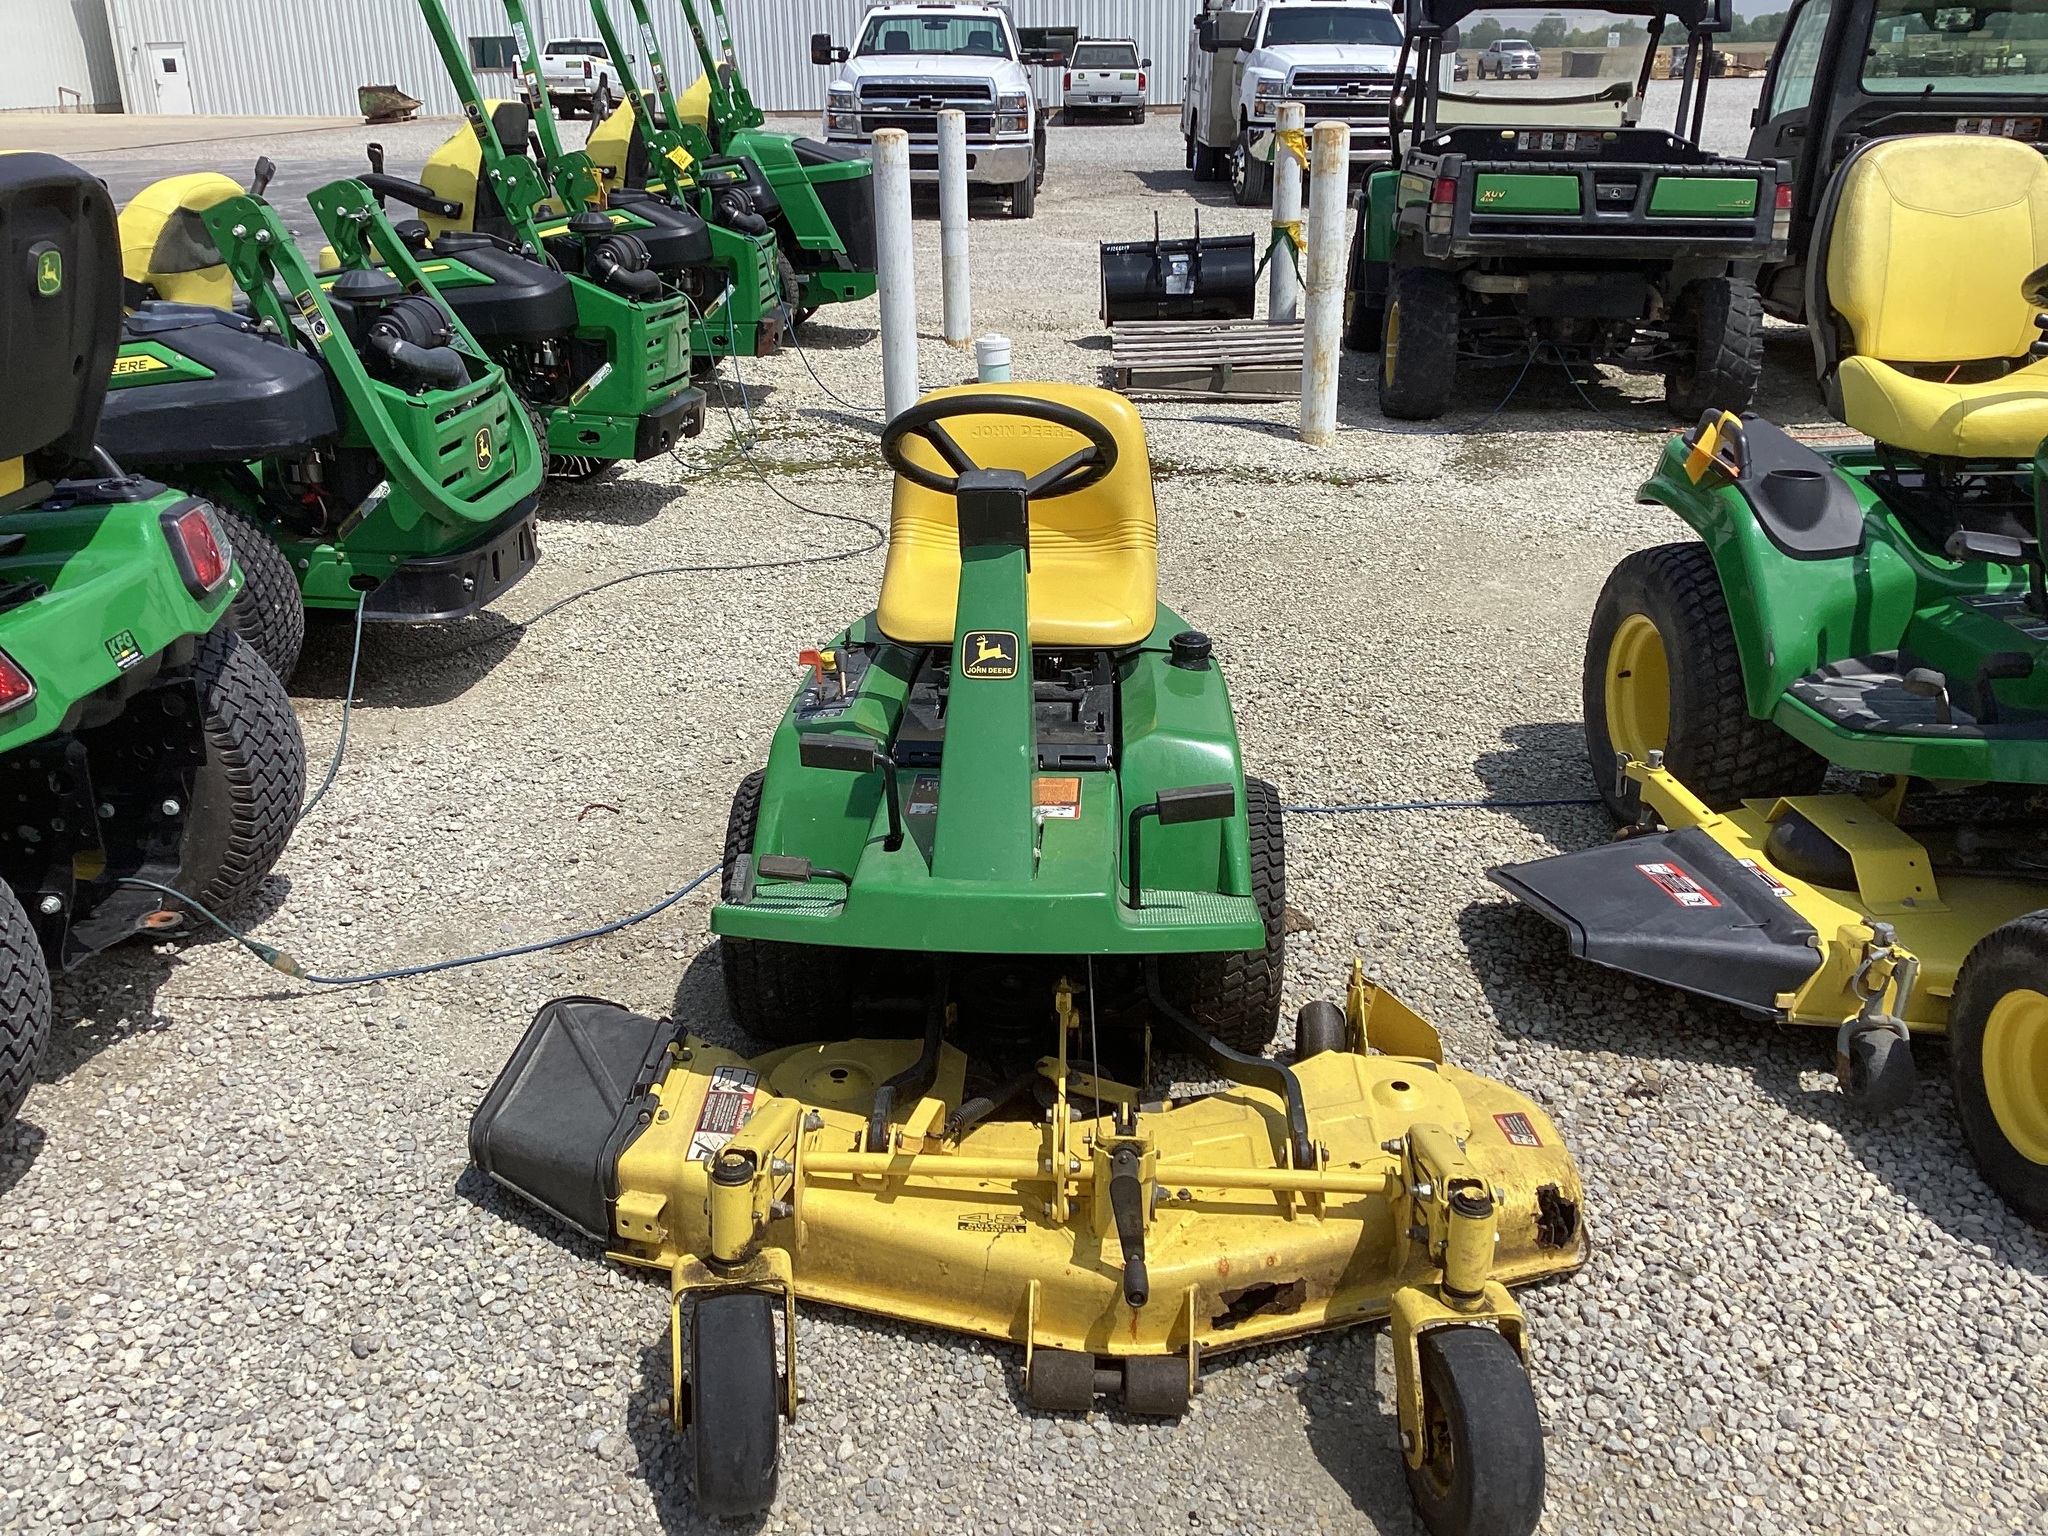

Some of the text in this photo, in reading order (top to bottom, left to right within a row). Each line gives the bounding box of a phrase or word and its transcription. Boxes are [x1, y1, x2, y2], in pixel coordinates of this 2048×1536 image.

[1484, 190, 1506, 198] XUV
[112, 359, 148, 372] EERE
[972, 425, 1073, 439] JOHN DEERE
